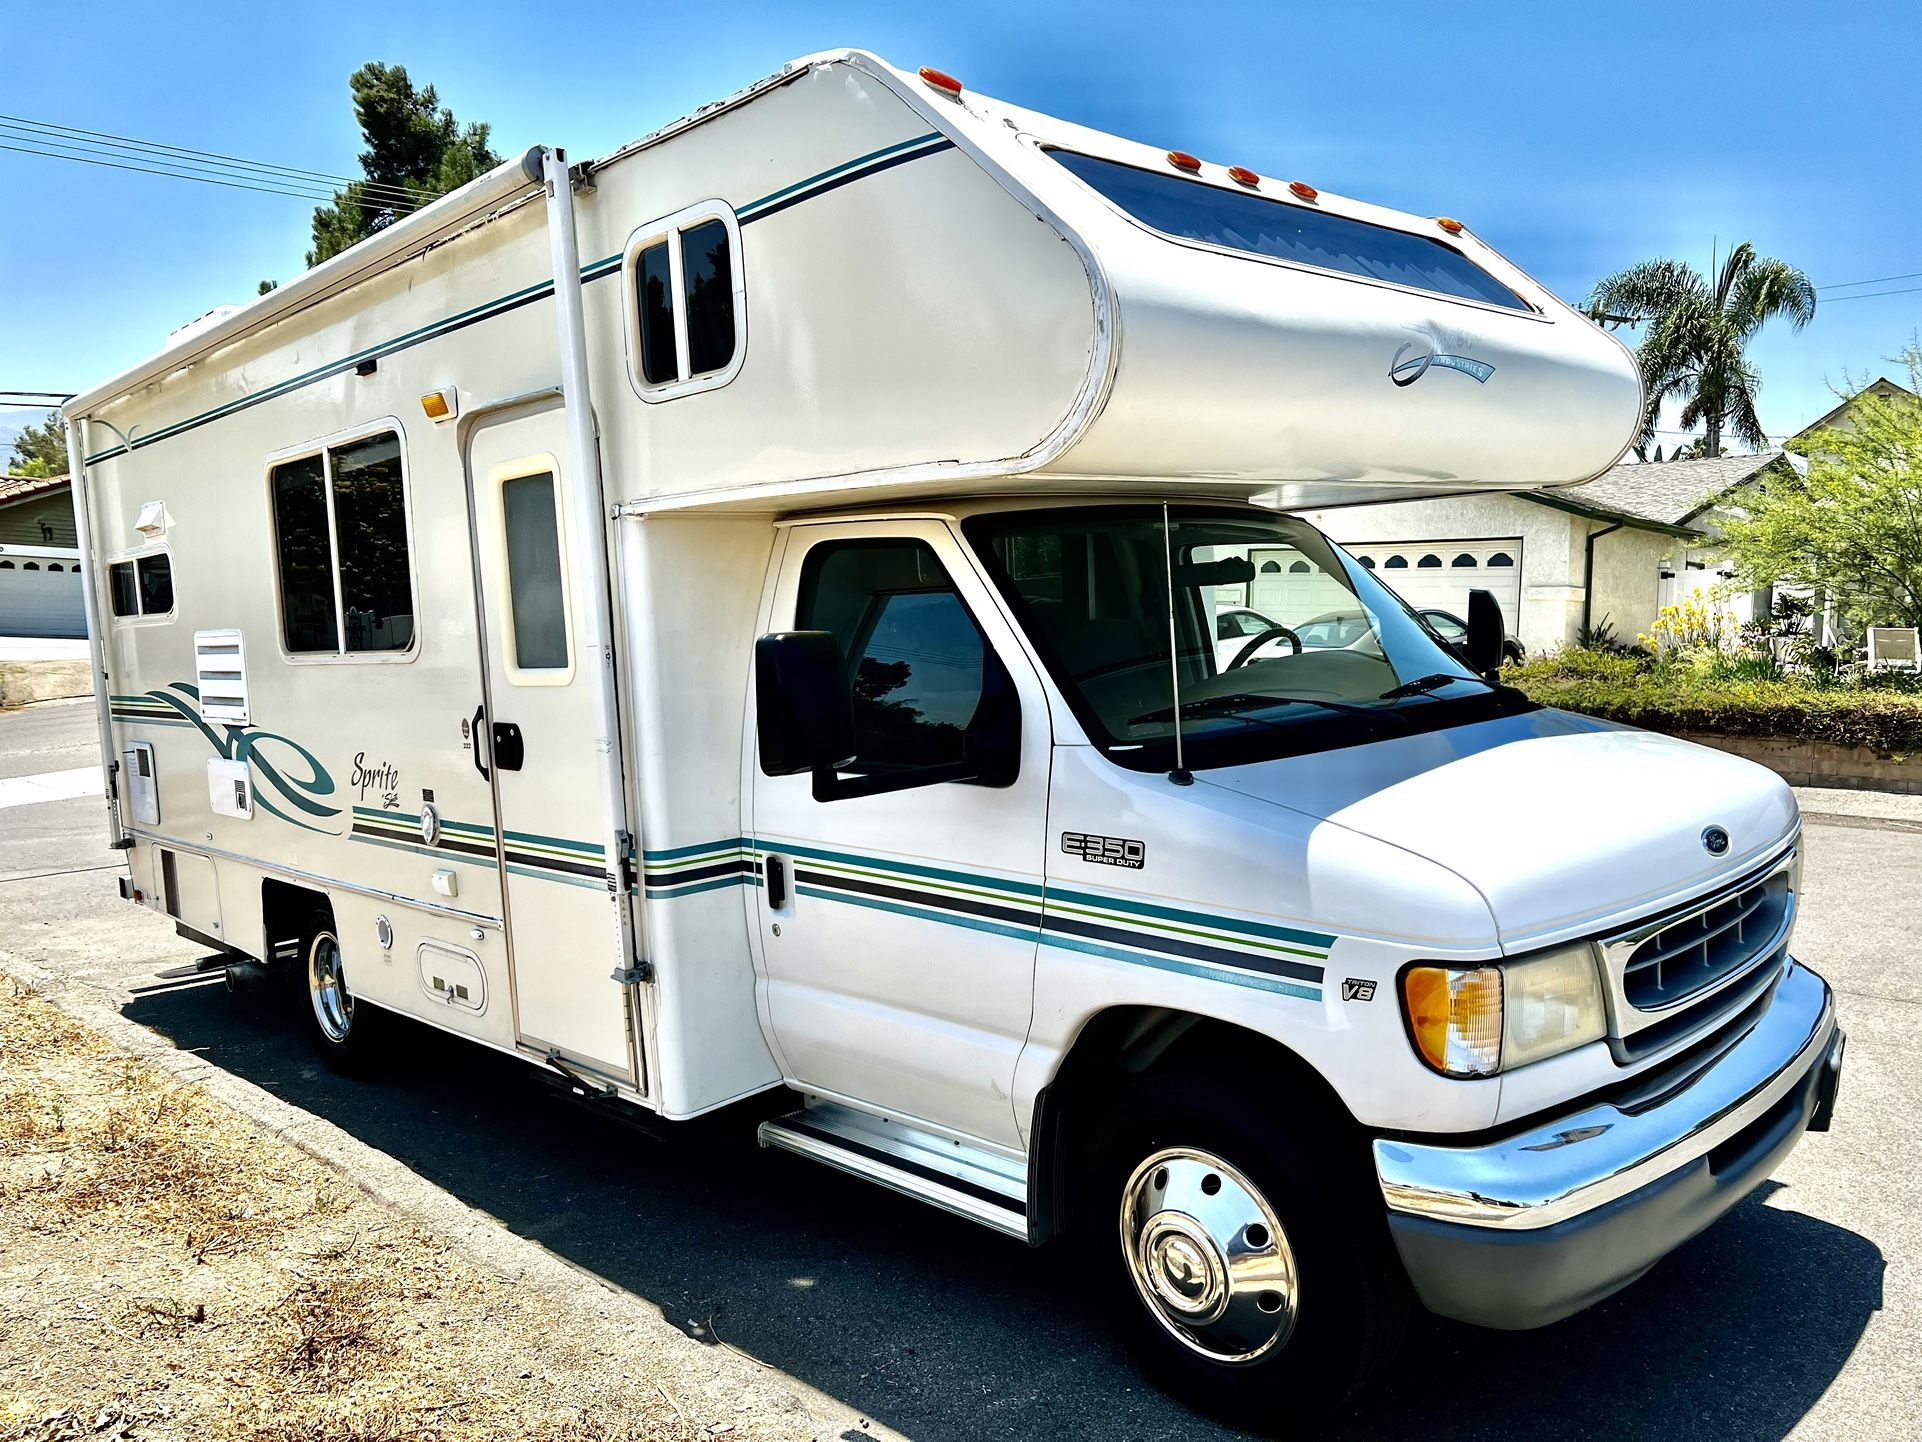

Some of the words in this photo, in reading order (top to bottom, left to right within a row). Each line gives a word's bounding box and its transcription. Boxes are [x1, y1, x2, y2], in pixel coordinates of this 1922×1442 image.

[1435, 355, 1484, 377] INDUSTRIES
[351, 752, 399, 801] Sprite
[1086, 854, 1115, 864] SUPER
[1116, 858, 1141, 867] DUTY
[1343, 983, 1374, 1000] V8
[1347, 978, 1376, 988] TRITON
